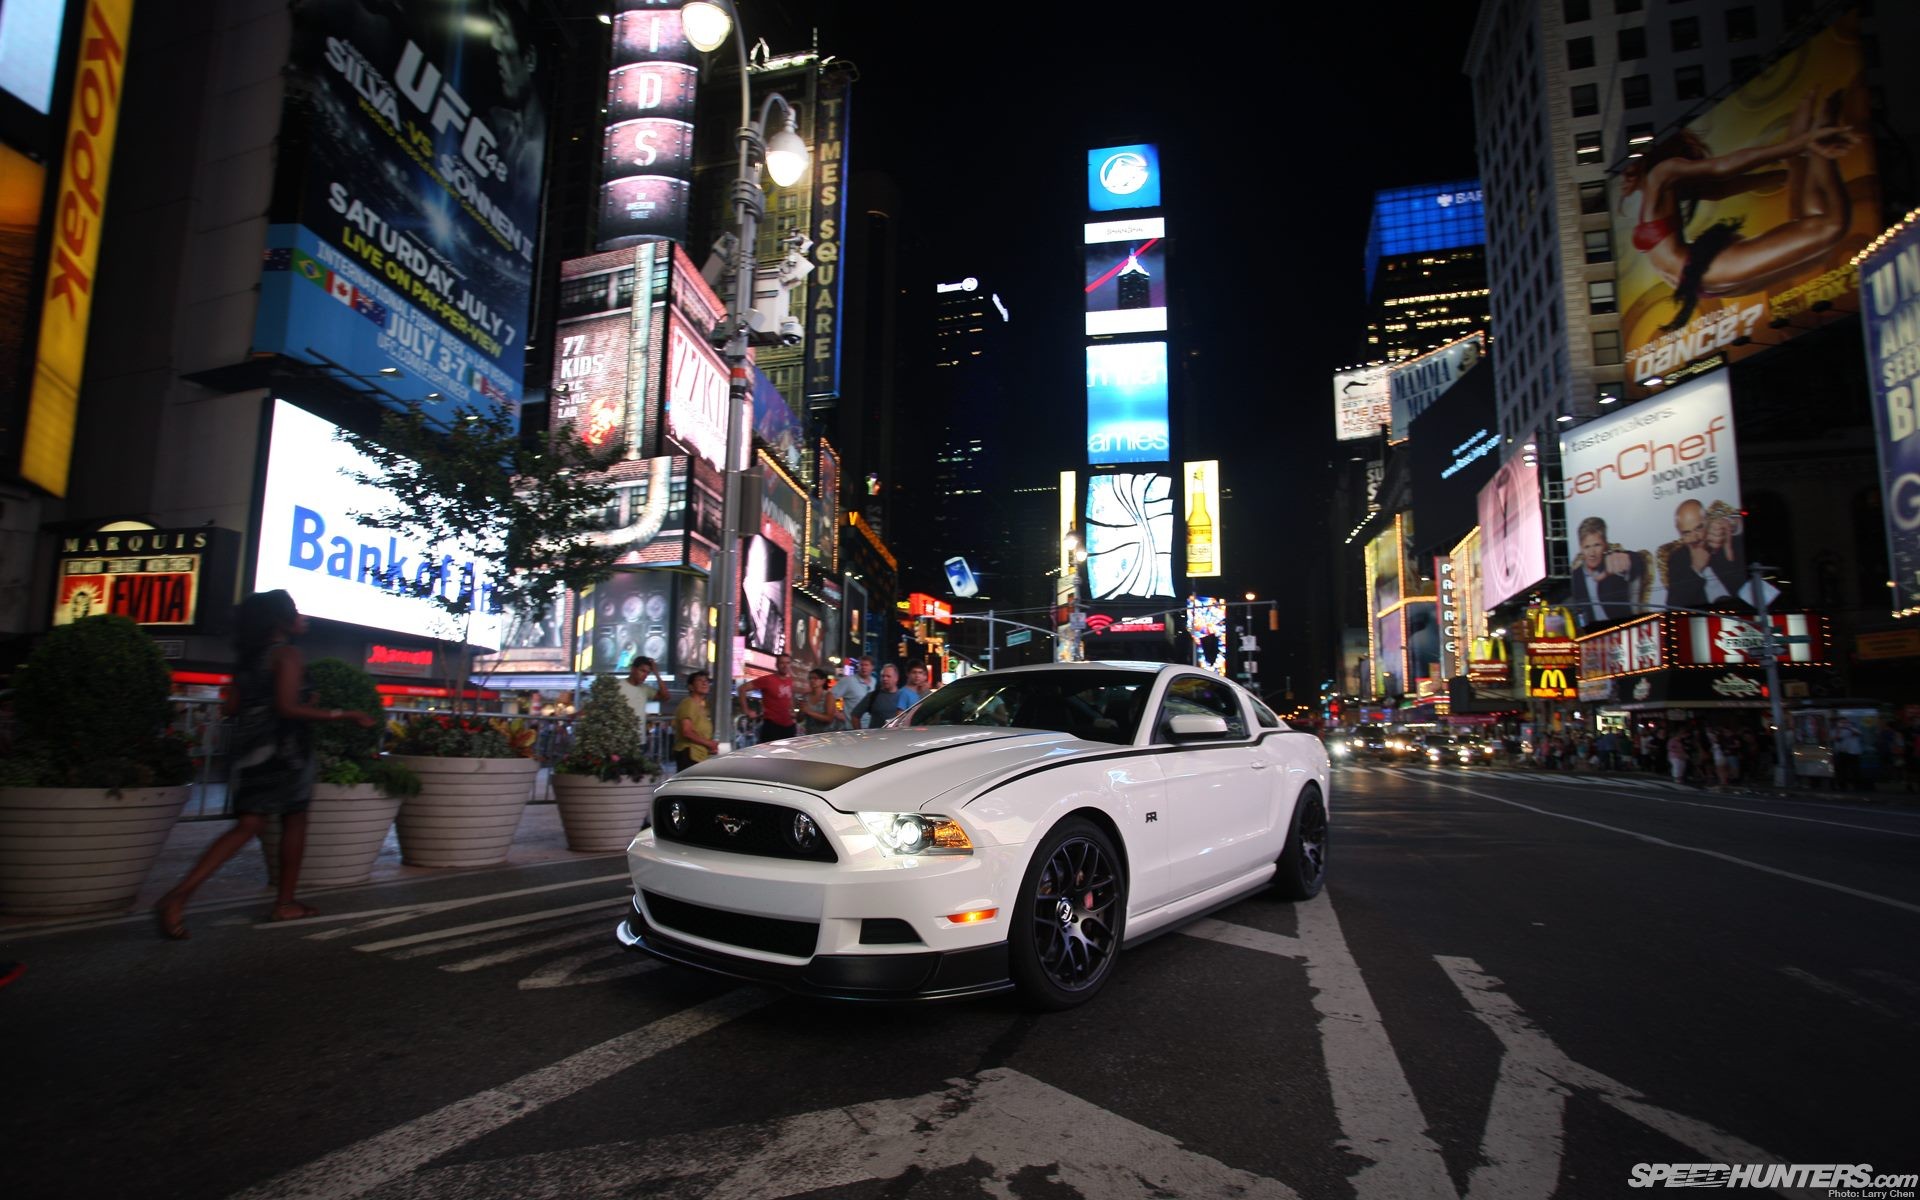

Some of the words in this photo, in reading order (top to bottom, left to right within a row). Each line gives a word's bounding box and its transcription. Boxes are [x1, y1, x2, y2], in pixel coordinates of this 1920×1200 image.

[394, 38, 498, 178] UFC
[633, 0, 668, 166] IDS
[51, 0, 123, 322] Kodak
[324, 35, 402, 132] SILVA
[440, 153, 522, 250] SONNEN
[820, 98, 841, 206] TIMES
[327, 182, 455, 303] SATURDAY,
[456, 289, 504, 337] JULY
[504, 324, 517, 347] 7
[342, 226, 383, 270] LIVE
[384, 254, 411, 292] ON
[412, 280, 504, 359] PAY-PER-VIEW
[814, 218, 840, 360] SQUARE
[386, 313, 436, 361] JULY
[560, 354, 604, 379] KIDS
[562, 334, 586, 357] 77
[1394, 358, 1452, 401] MAMMA
[1652, 467, 1683, 486] MON
[1688, 456, 1718, 474] TUE
[1676, 473, 1706, 494] FOX
[1706, 470, 1719, 485] 5
[62, 532, 208, 553] MARQUIS
[289, 504, 409, 596] Bank
[112, 573, 186, 624] EVITA
[1441, 563, 1456, 653] PALACE
